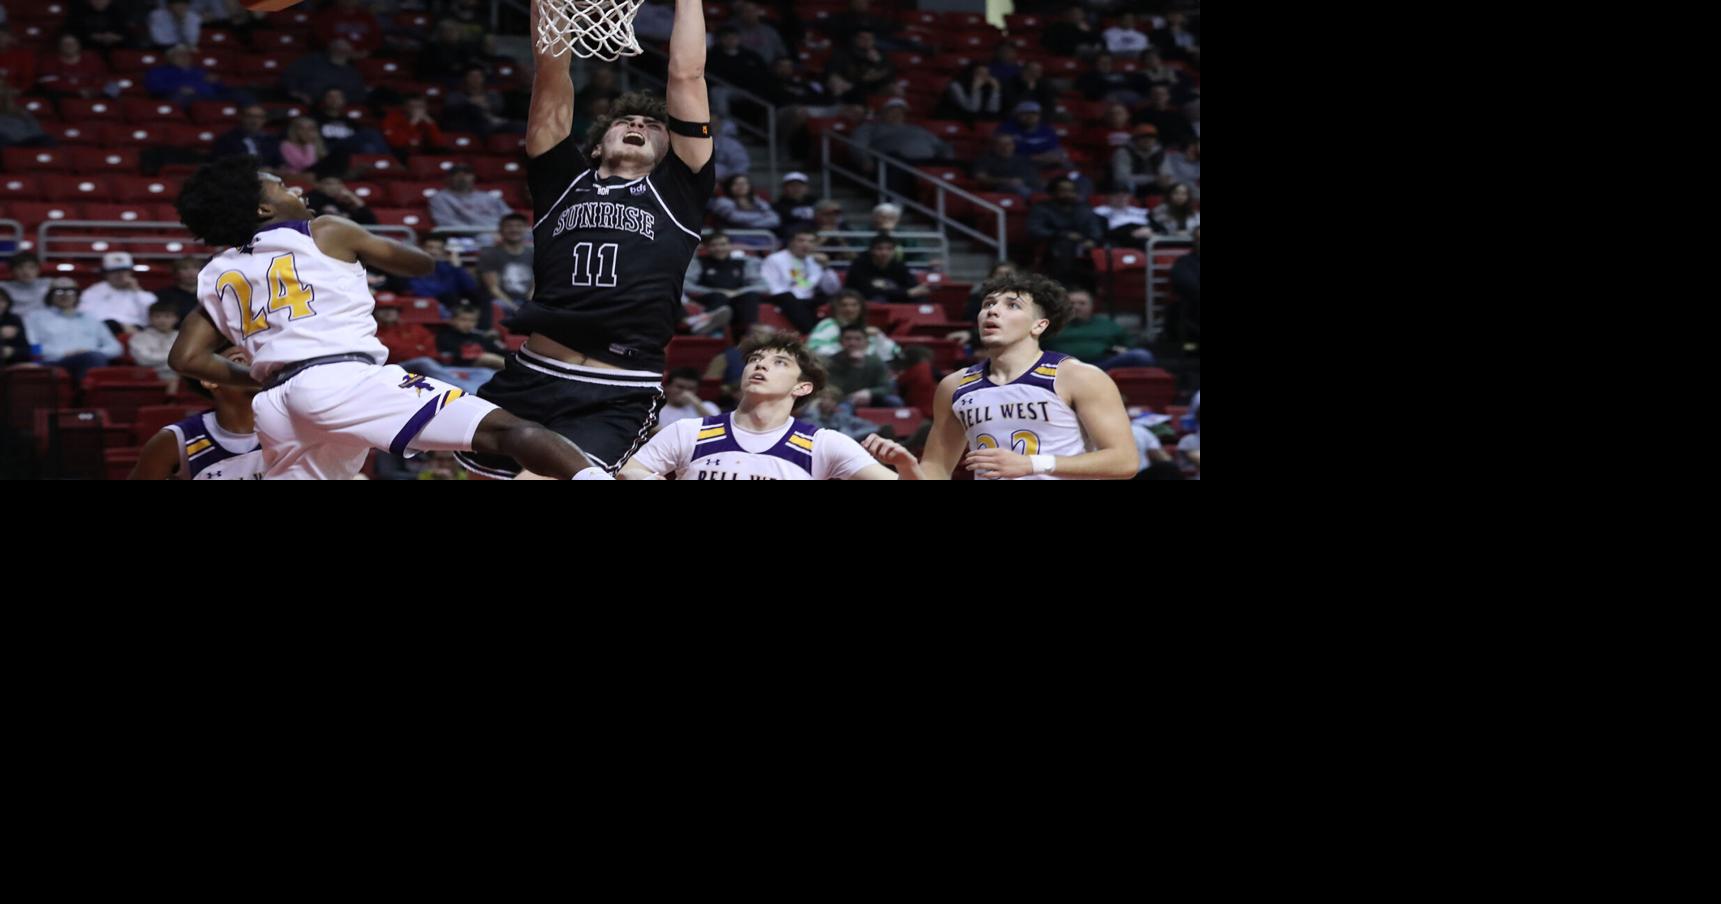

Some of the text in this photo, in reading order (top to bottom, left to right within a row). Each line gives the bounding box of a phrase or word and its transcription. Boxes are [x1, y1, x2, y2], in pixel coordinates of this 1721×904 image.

[552, 202, 655, 240] SUNRISE
[572, 242, 618, 287] 11
[215, 251, 317, 341] 24
[1001, 401, 1050, 422] WEST
